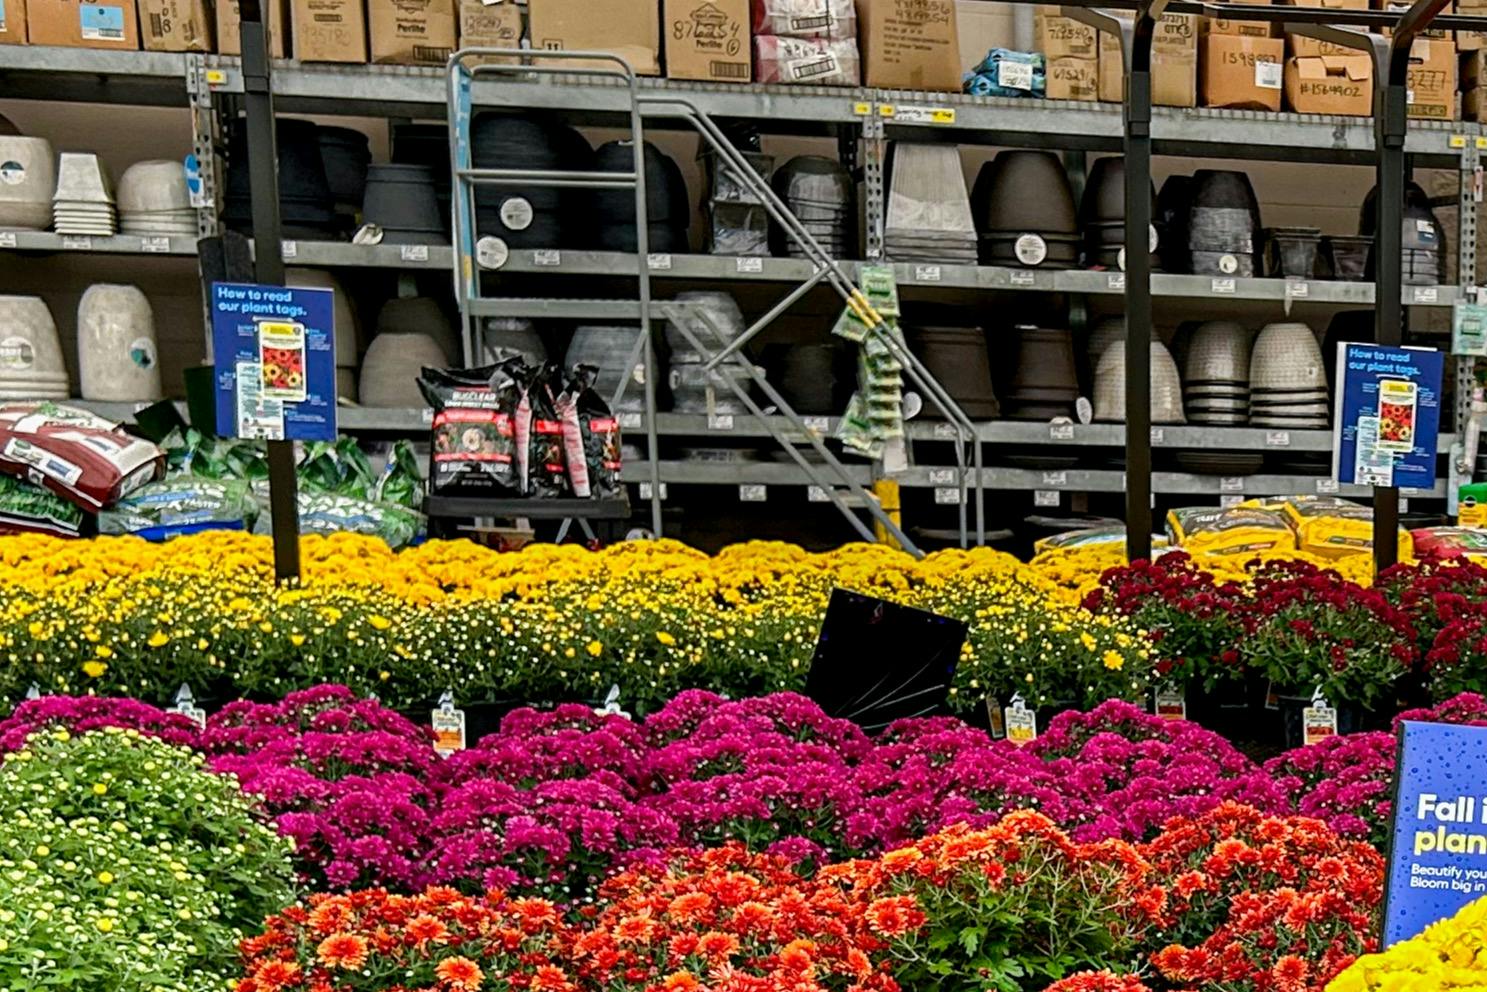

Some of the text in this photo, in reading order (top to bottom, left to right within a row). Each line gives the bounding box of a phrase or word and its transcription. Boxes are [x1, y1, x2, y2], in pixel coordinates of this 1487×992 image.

[218, 287, 292, 302] How to read
[218, 302, 307, 317] our plant tags.
[1350, 348, 1411, 363] How to read
[1348, 361, 1421, 376] our plant tags.
[1417, 793, 1474, 823] Fall
[1411, 863, 1462, 878] Beautify
[1410, 875, 1449, 890] Bloom
[1451, 878, 1472, 893] big
[1474, 880, 1485, 891] in
